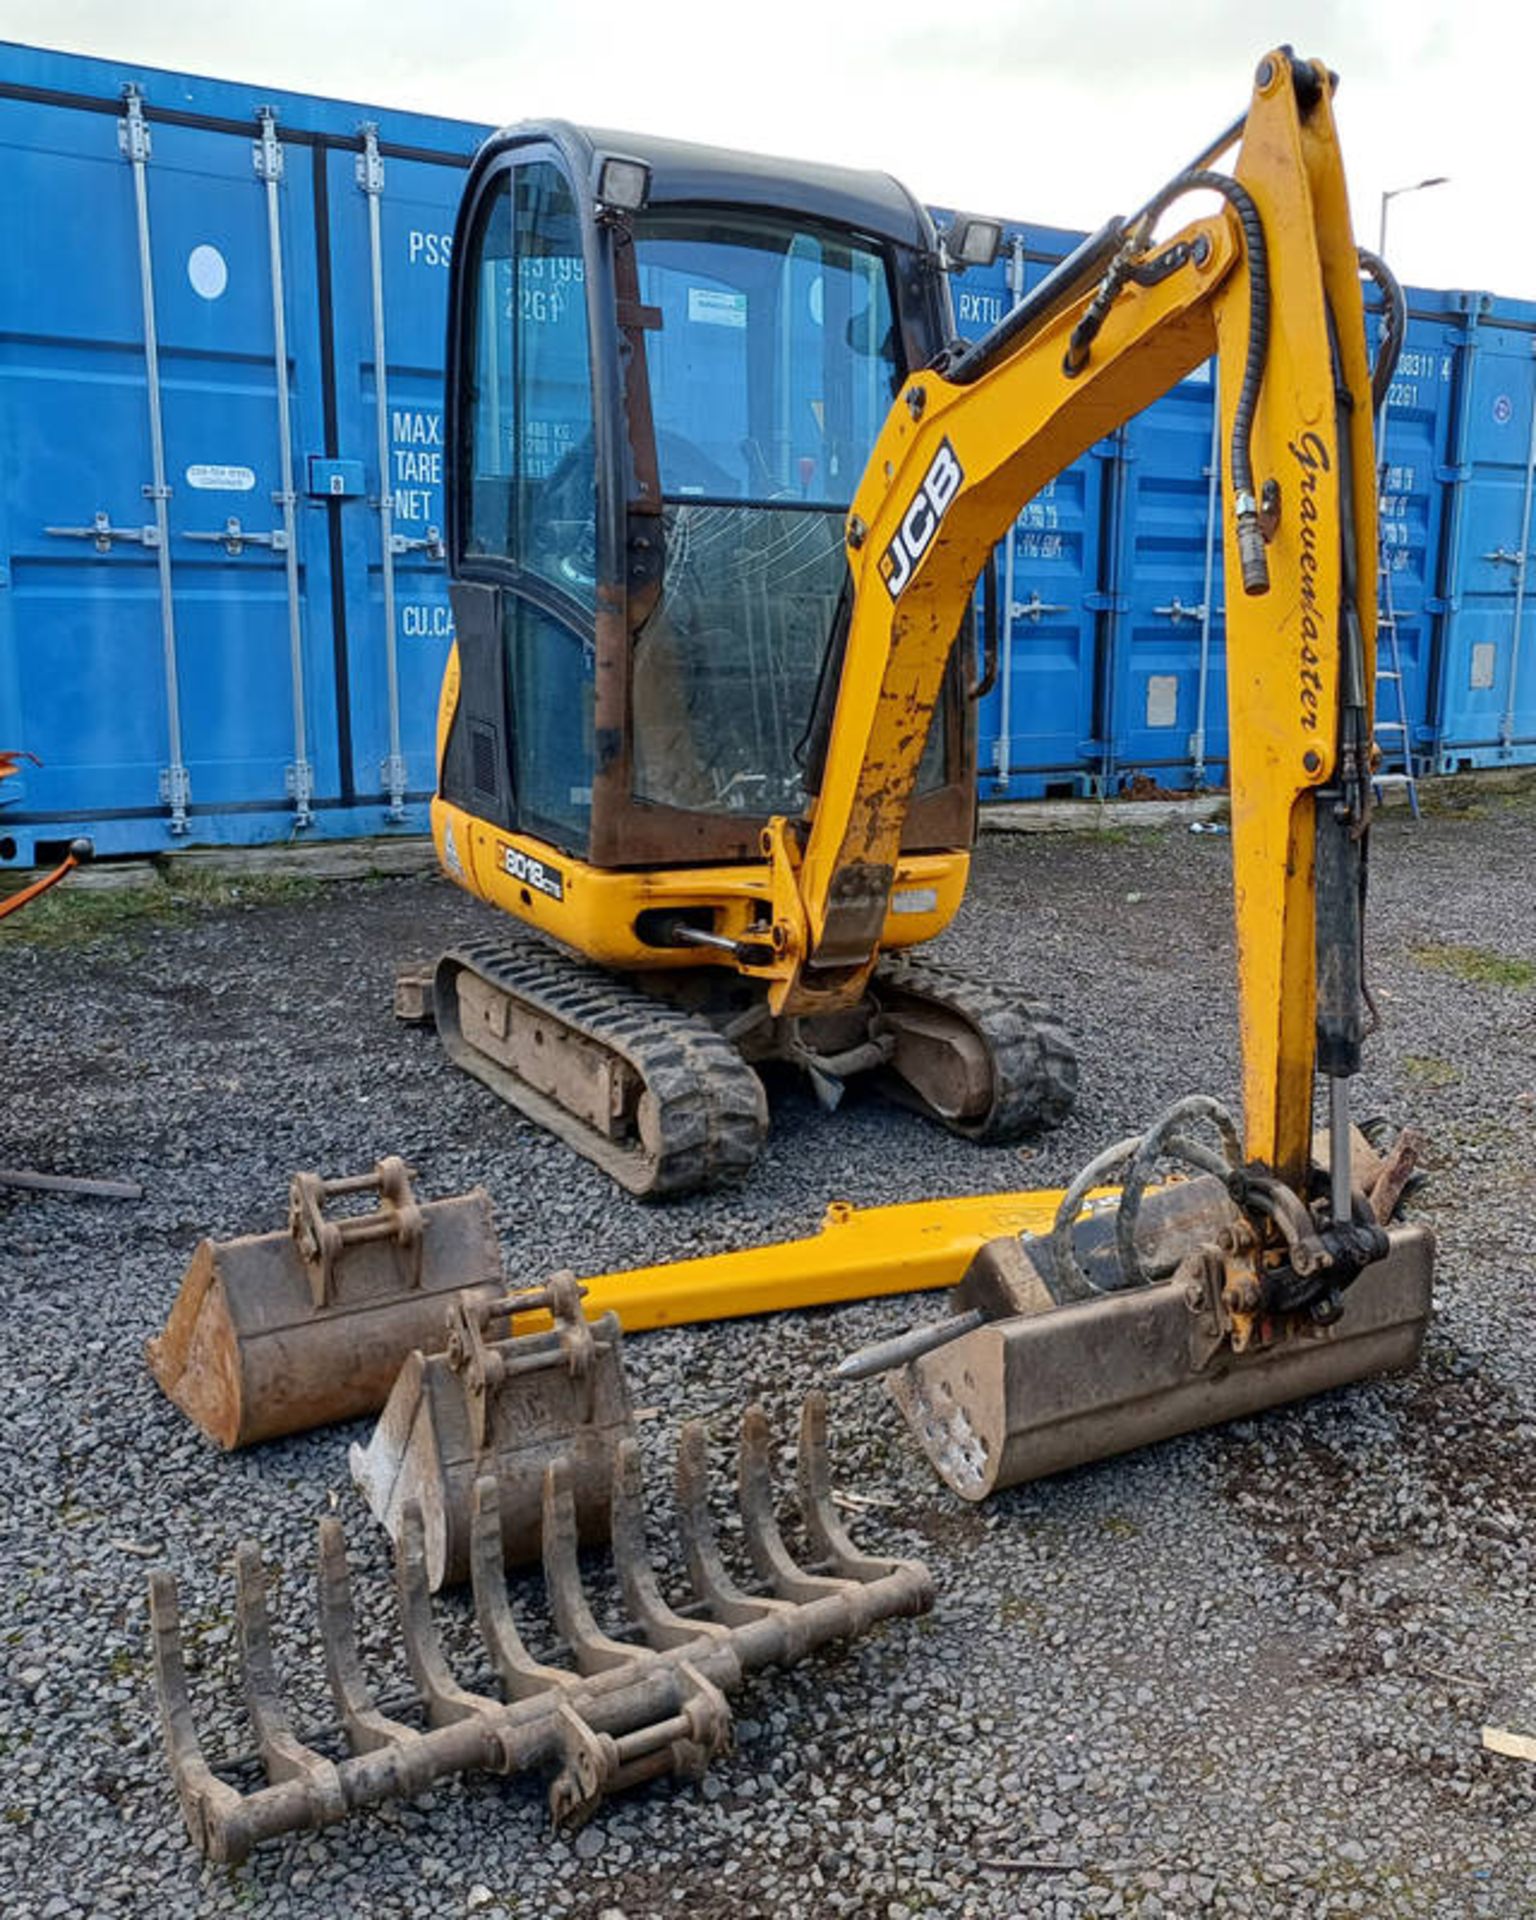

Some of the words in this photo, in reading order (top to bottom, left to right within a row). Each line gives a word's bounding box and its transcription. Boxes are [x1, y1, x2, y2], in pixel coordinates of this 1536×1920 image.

[959, 294, 1002, 325] RXTU
[393, 450, 442, 484] TARE
[395, 488, 433, 520] NET
[887, 447, 961, 596] JCB
